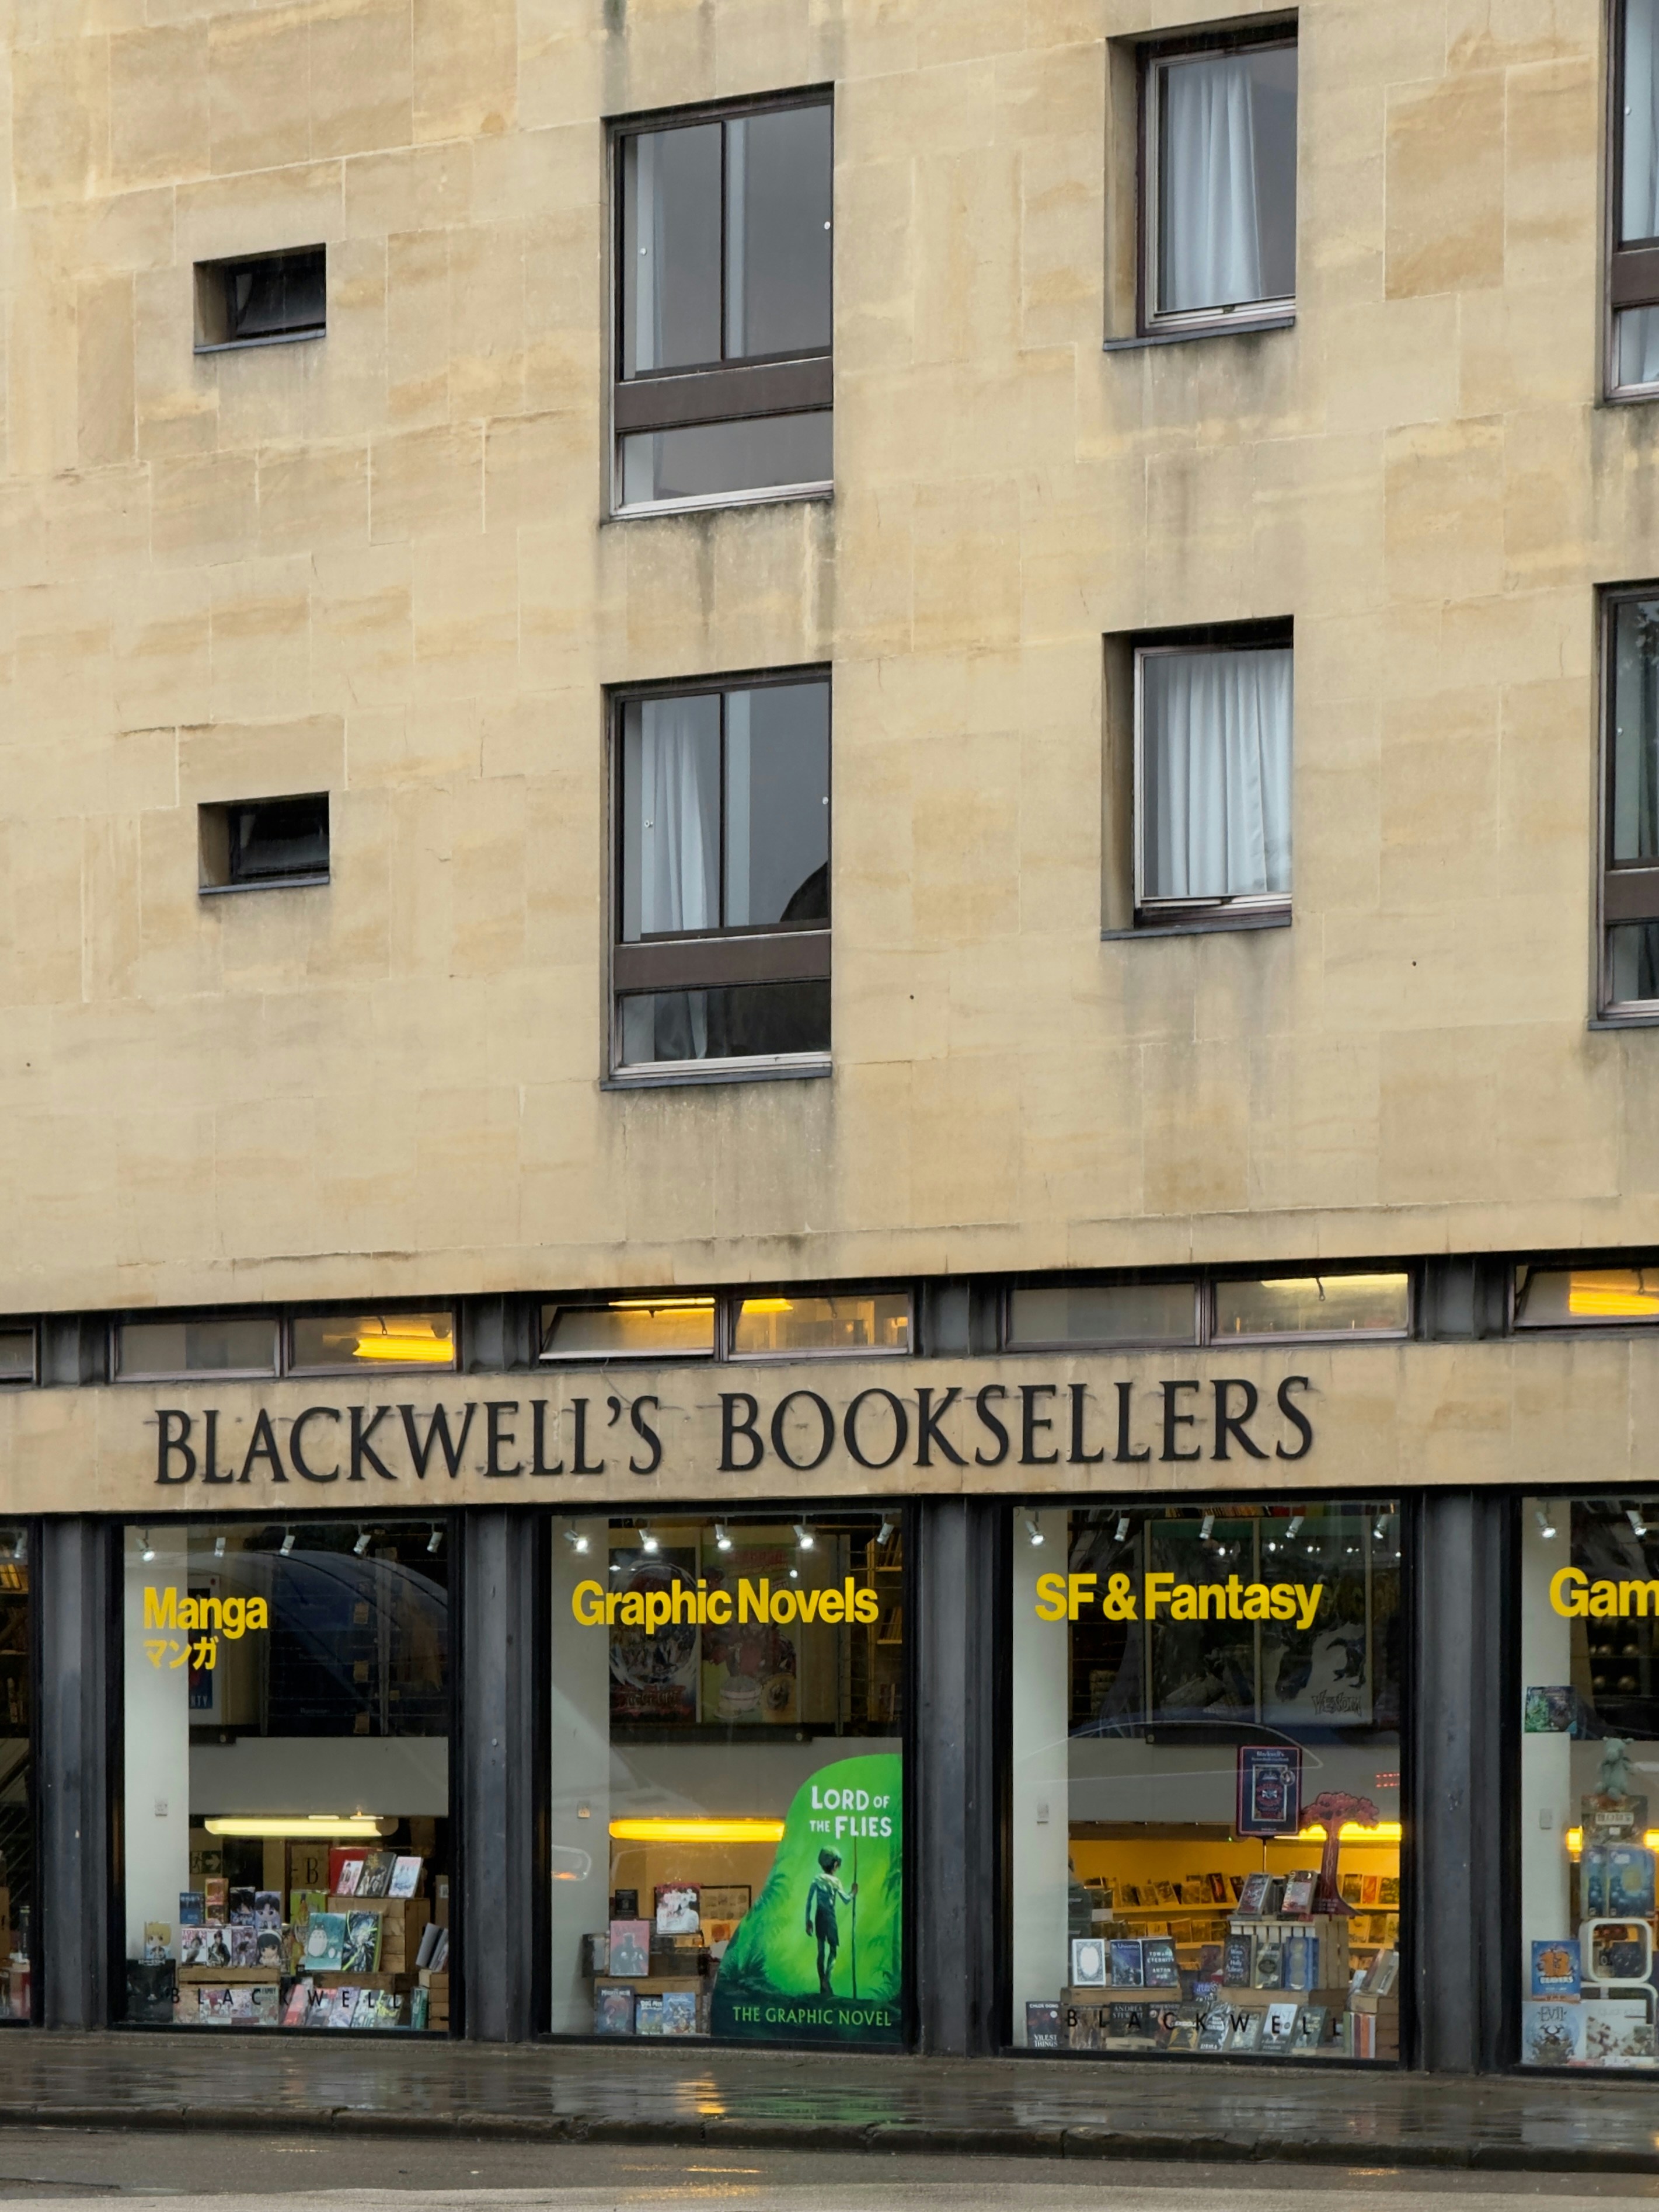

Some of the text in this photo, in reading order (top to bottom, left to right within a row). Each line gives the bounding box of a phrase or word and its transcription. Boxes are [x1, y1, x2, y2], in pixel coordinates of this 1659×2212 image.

[155, 1376, 1312, 1485] BLACKWELL'S BOOKSELLERS
[144, 1585, 268, 1639] Manga
[571, 1576, 879, 1635] Graphic Novels
[1034, 1572, 1323, 1630] SF & Fantasy
[144, 1636, 219, 1670] マンガ
[811, 1785, 890, 1810] LORD OF
[809, 1815, 893, 1839] THE FLIES
[733, 2007, 891, 2026] THE GRAPHIC NOVEL
[1067, 2009, 1343, 2036] BLACKWELL
